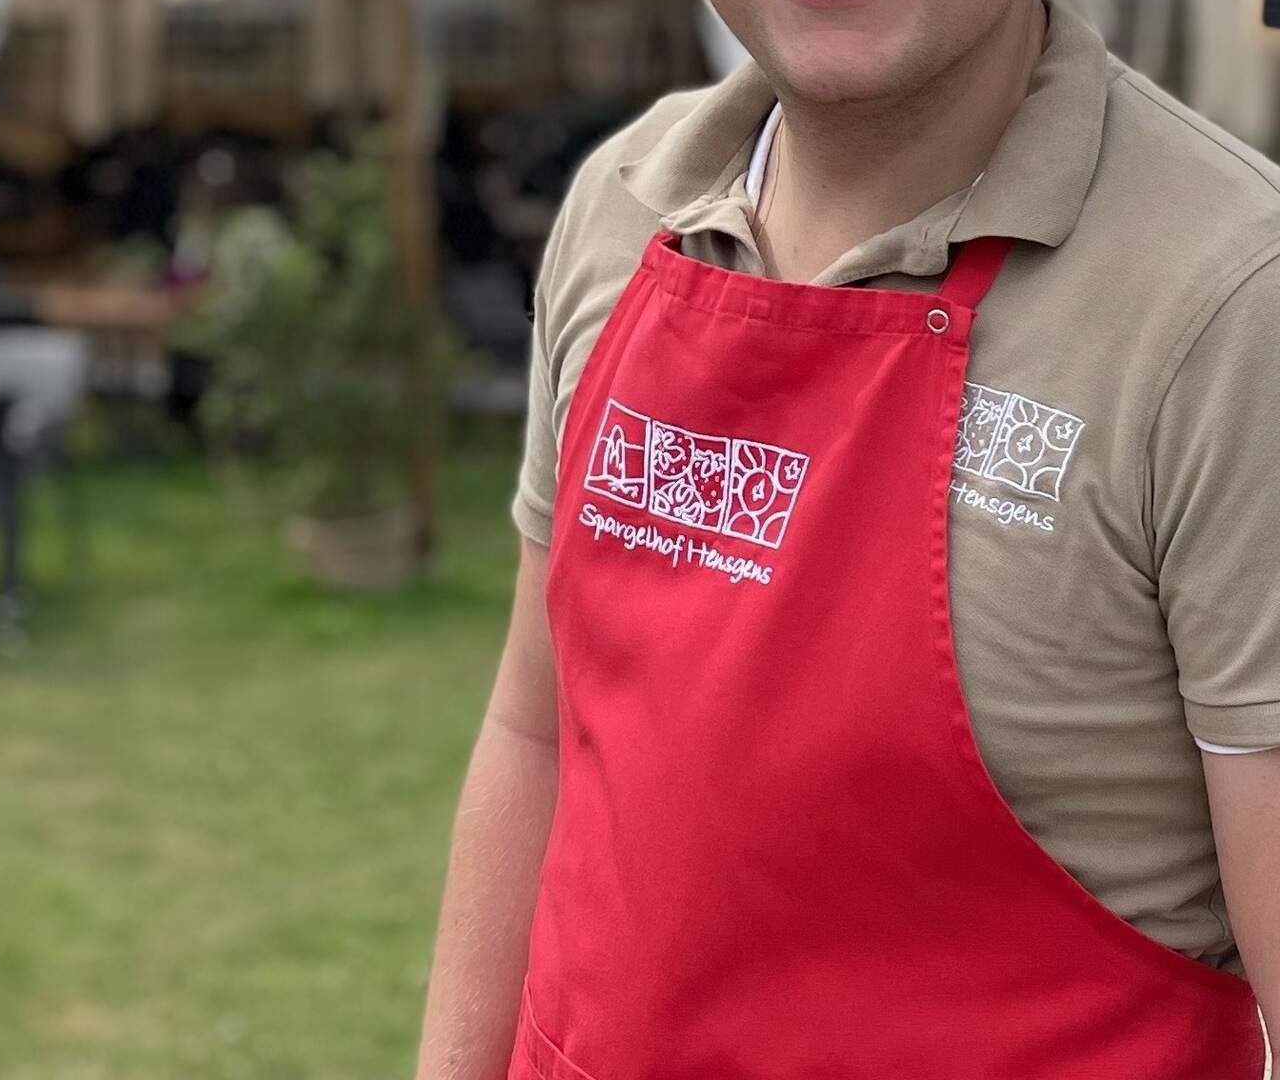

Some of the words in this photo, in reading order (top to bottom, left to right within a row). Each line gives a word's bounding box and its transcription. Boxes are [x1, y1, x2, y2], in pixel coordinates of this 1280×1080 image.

[949, 478, 1055, 532] Hensgens
[579, 504, 684, 568] Spargelhof
[687, 538, 772, 585] Hensgens
